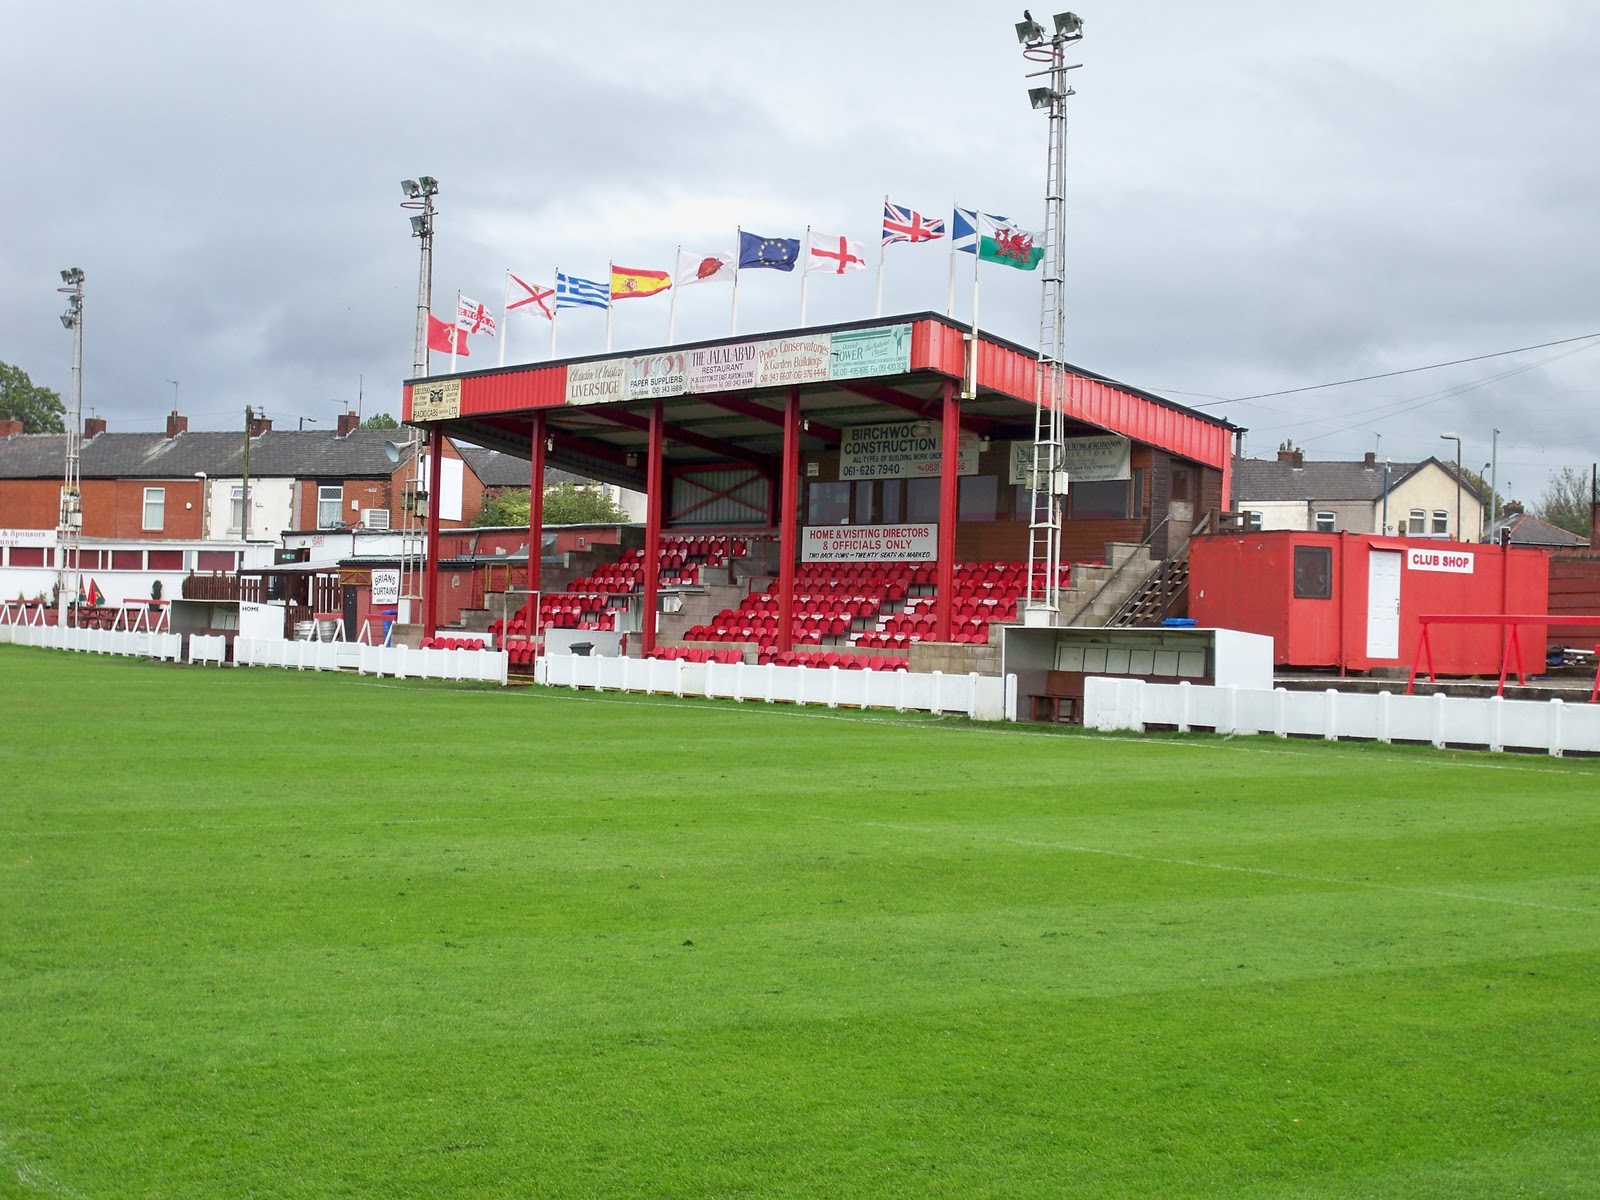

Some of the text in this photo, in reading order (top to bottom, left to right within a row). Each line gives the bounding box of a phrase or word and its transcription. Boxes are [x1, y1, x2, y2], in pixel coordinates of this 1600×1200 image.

[759, 340, 829, 364] Priory Conservatories
[835, 347, 863, 362] TOWER
[692, 352, 706, 367] THE
[764, 361, 769, 370] &
[770, 359, 792, 370] Garden
[794, 356, 822, 369] Buildings
[702, 363, 744, 374] RESTAURANT
[630, 375, 683, 388] PAPER SUPPLIERS
[571, 380, 619, 398] LIVERSIDGE
[449, 406, 458, 415] LTD
[844, 438, 936, 455] CONSTRUCTION
[863, 455, 879, 463] TYPES
[888, 454, 912, 462] BUILDING
[913, 452, 928, 460] WORK
[843, 465, 875, 477] 061-626
[878, 464, 900, 475] 7940
[10, 530, 46, 538] Sponsors
[810, 528, 929, 540] HOME & VISITING DIRECTORS
[822, 540, 912, 550] & OFFICIALS ONLY
[1412, 554, 1470, 568] CLUB SHOP
[374, 574, 396, 586] BRIANS
[373, 587, 397, 596] CURTAINS
